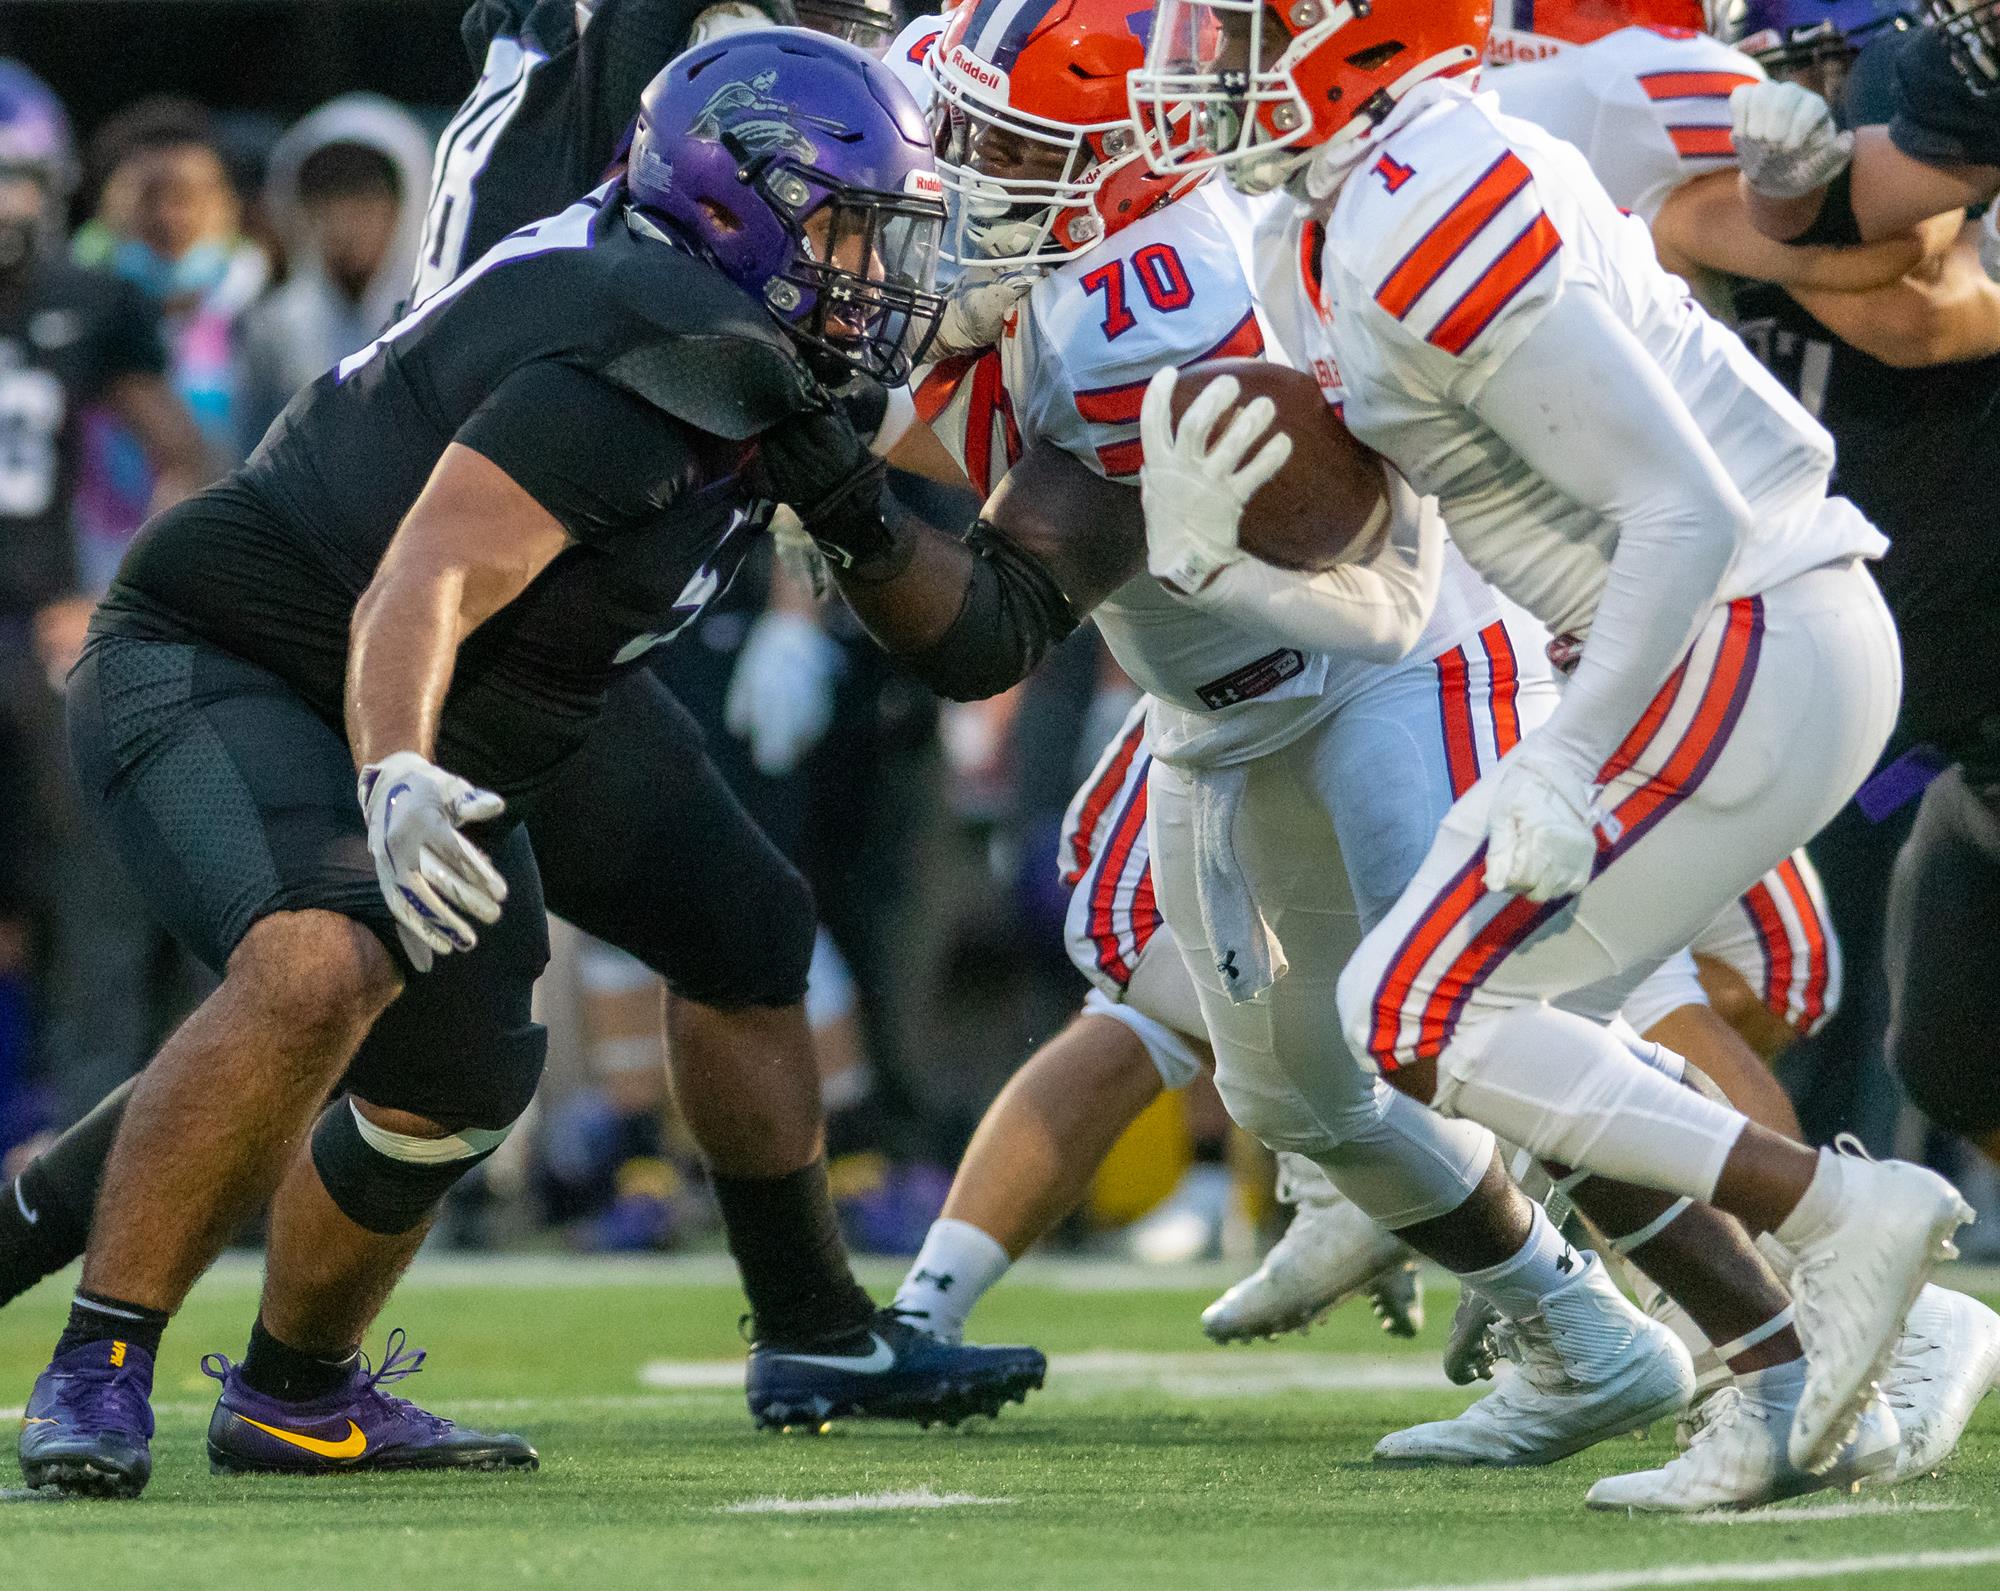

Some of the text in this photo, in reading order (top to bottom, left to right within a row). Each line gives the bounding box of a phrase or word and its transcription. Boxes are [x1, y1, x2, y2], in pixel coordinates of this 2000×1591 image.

[952, 49, 1000, 90] Riddell
[916, 175, 943, 193] Ridd
[1370, 151, 1417, 196] 1
[1079, 242, 1195, 343] 70
[109, 1340, 127, 1368] VPR
